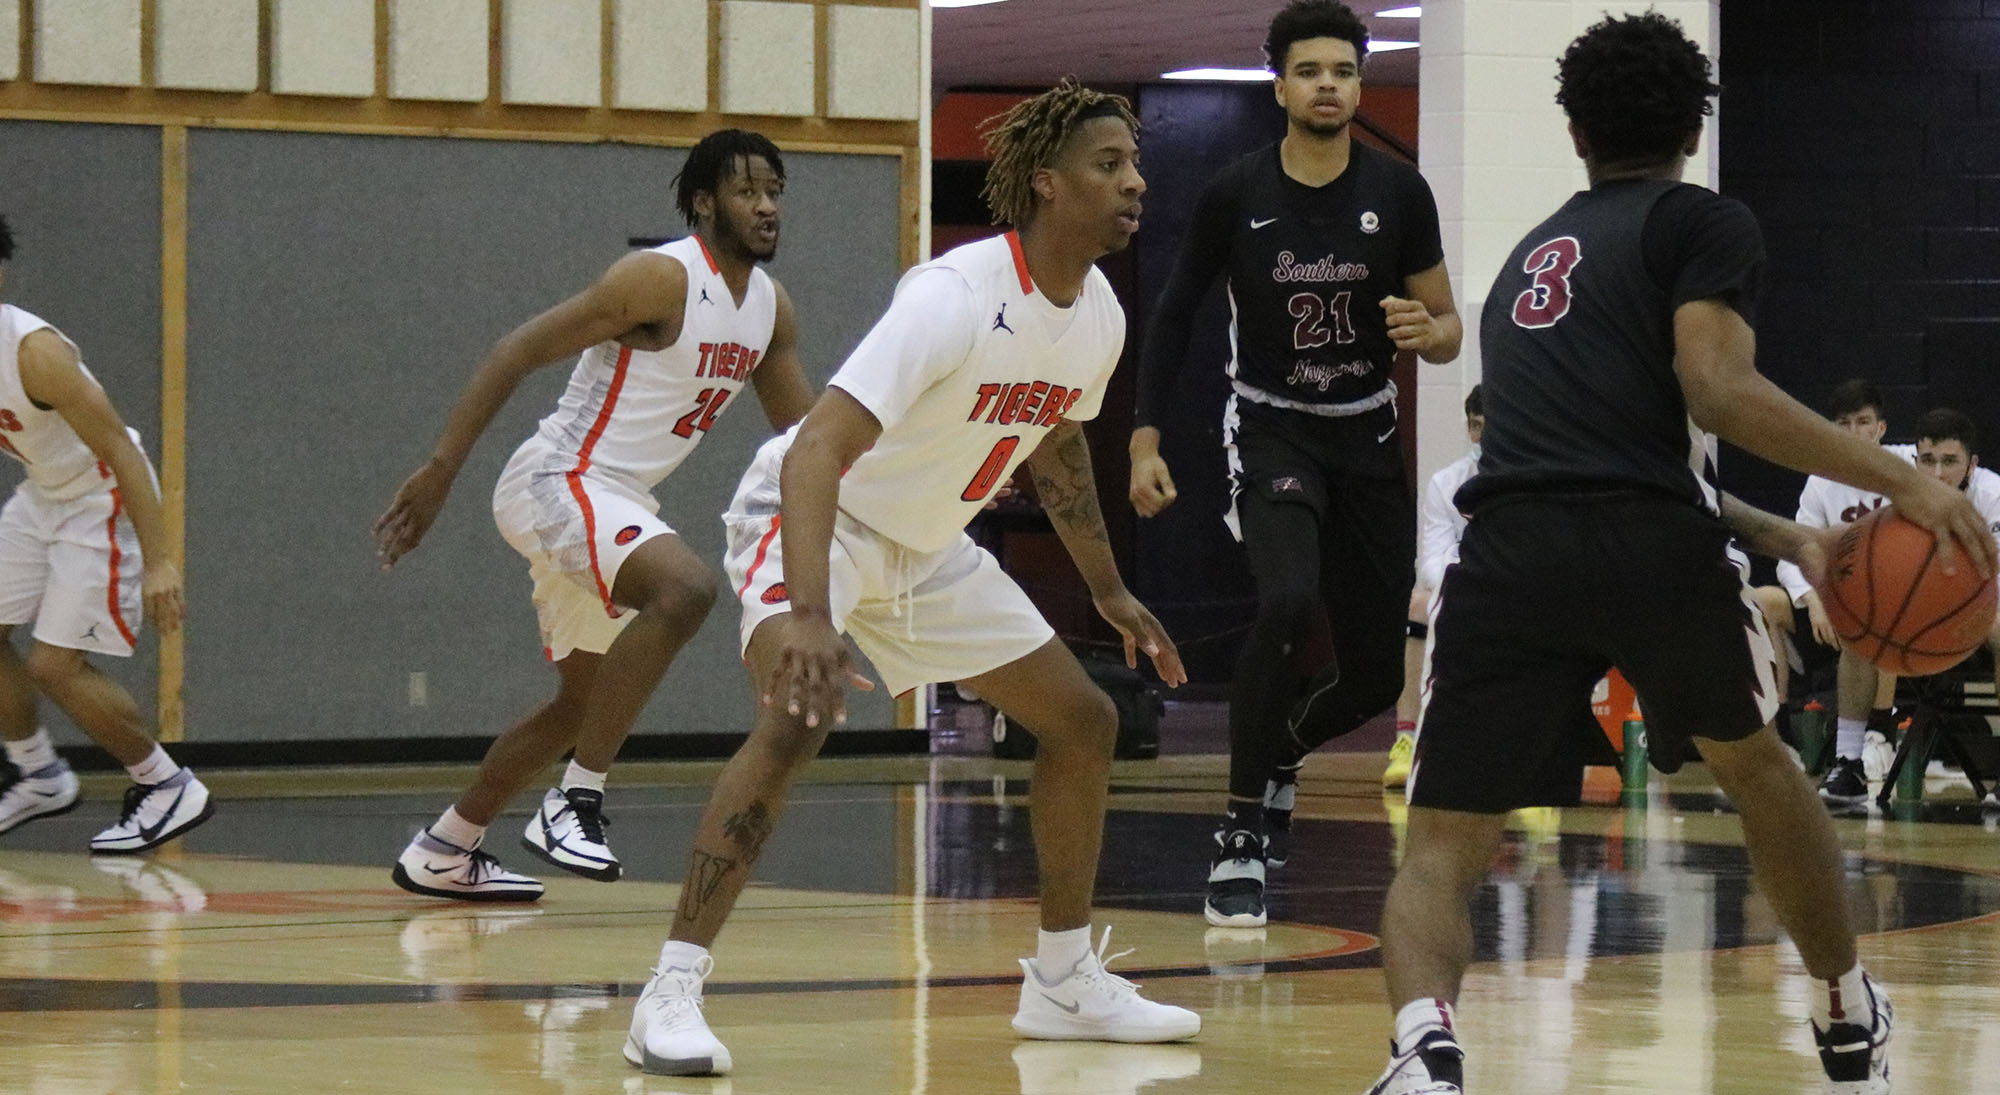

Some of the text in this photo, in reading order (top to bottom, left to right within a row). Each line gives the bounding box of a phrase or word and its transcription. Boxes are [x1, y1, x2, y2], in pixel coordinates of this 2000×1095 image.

[1273, 250, 1369, 283] Southern
[1511, 236, 1583, 329] 3
[1287, 291, 1355, 350] 21
[960, 435, 1020, 502] 0
